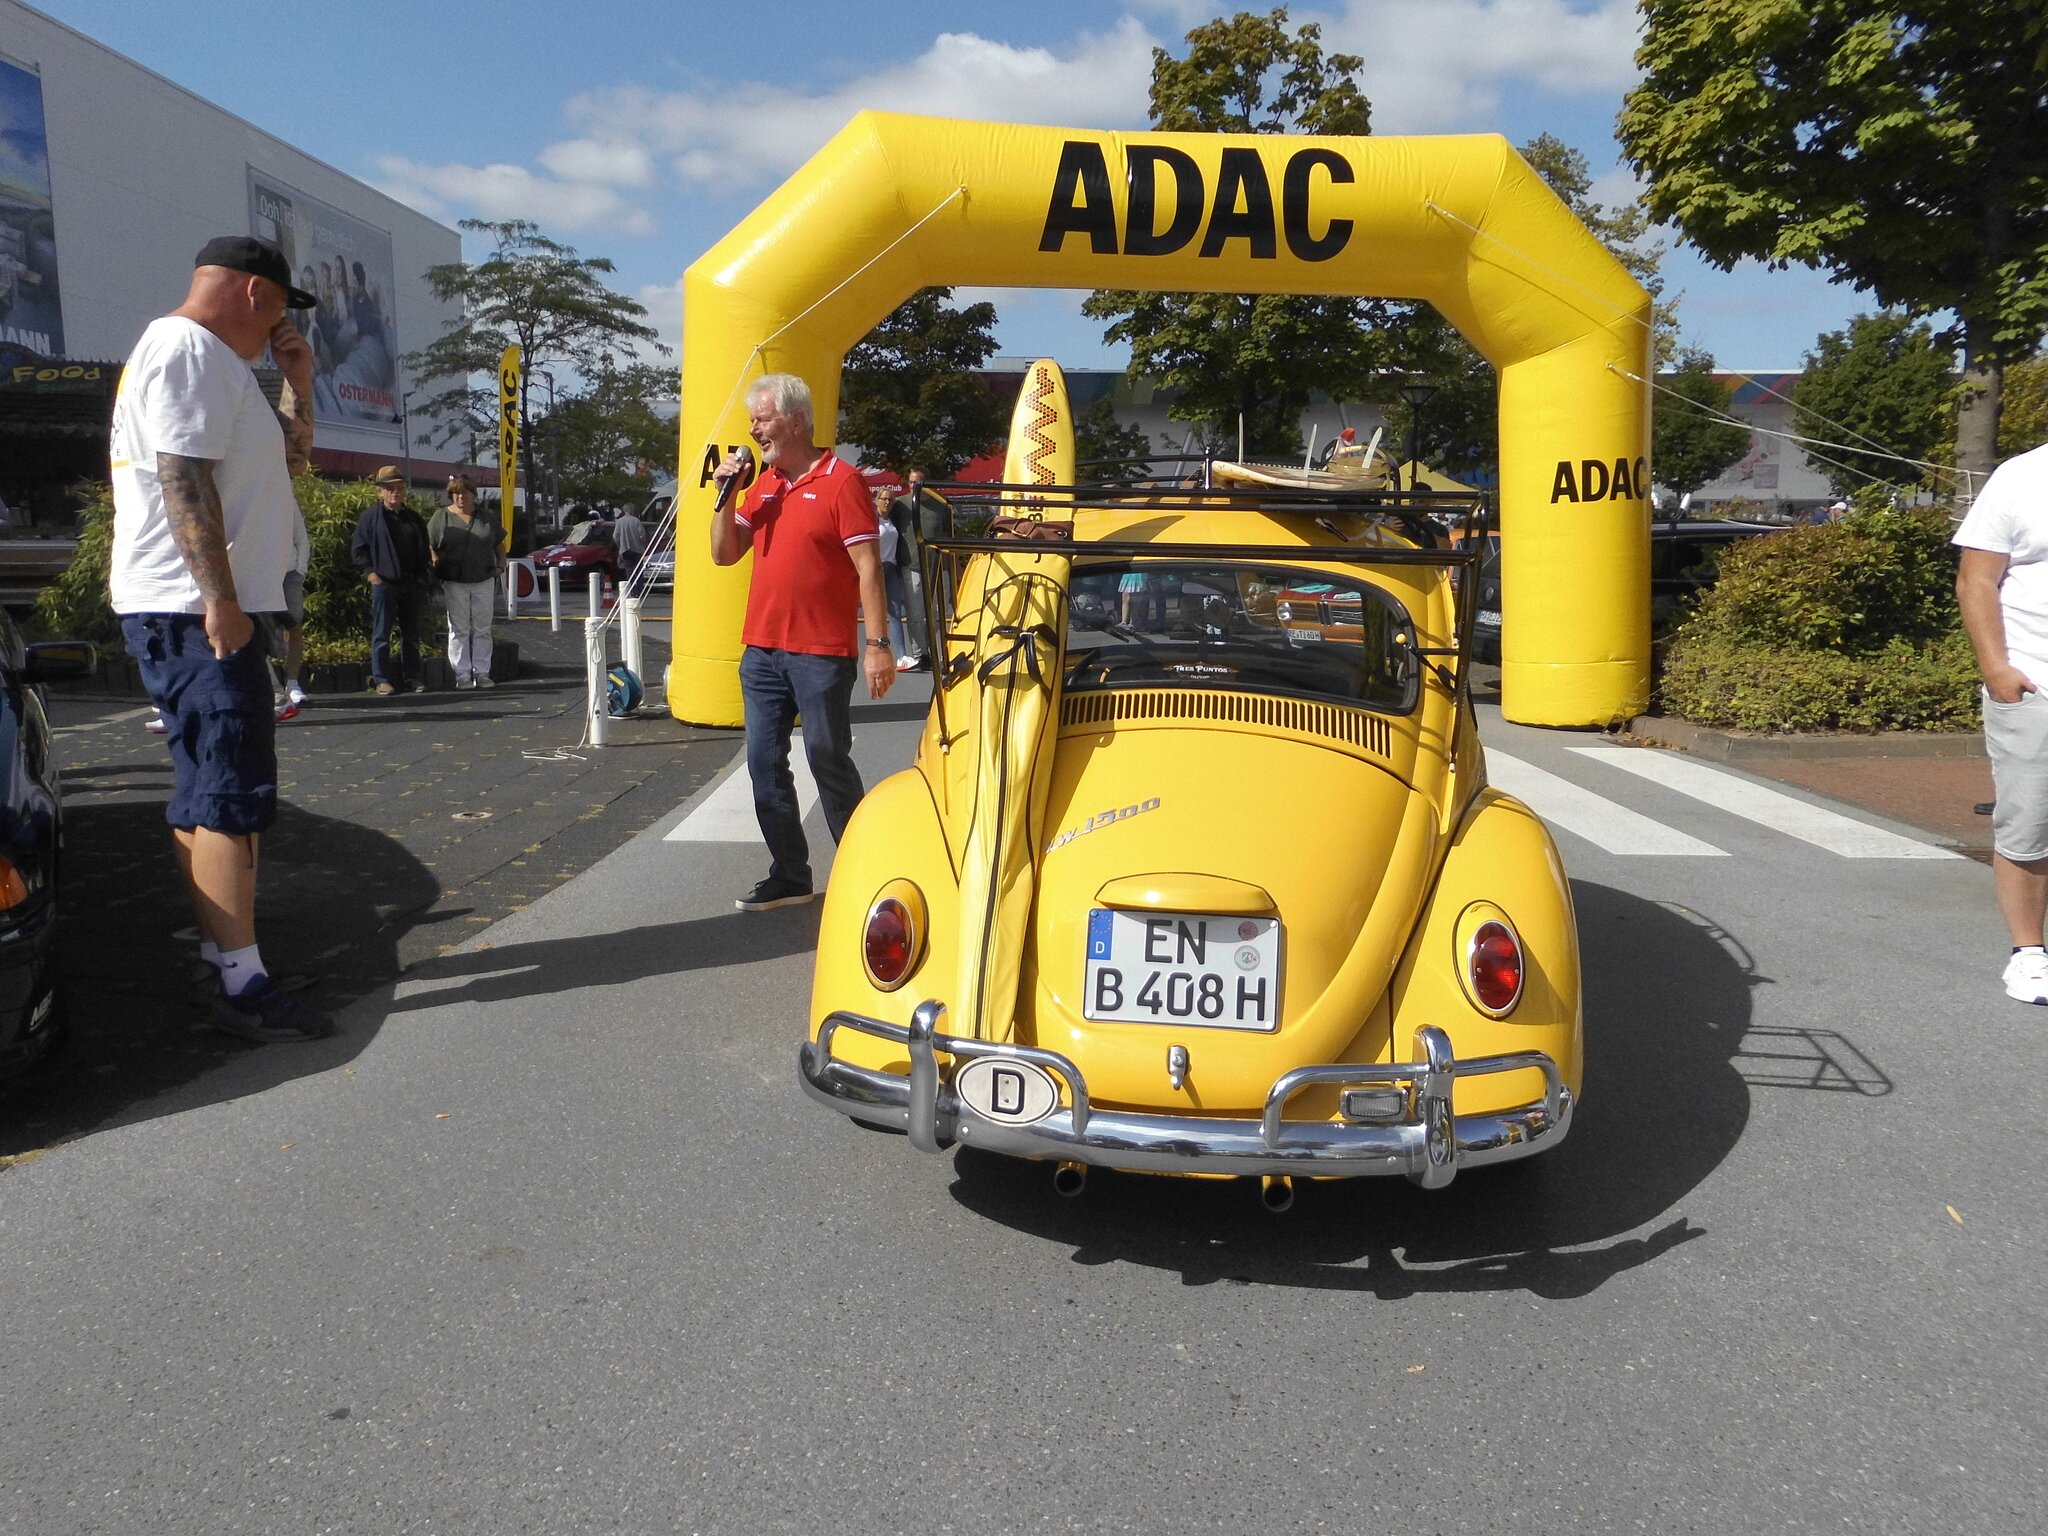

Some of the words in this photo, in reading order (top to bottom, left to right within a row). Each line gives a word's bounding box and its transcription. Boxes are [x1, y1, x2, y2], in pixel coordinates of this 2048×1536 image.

[1038, 141, 1355, 262] ADAC
[0, 322, 51, 357] ANN
[339, 382, 395, 407] OSTERMANN
[1550, 456, 1647, 504] ADAC
[1084, 797, 1160, 834] 1500
[1095, 941, 1105, 954] D
[1145, 918, 1206, 965] EN
[1096, 967, 1123, 1011] B
[1136, 970, 1224, 1019] 408
[1236, 975, 1266, 1021] H
[991, 1067, 1025, 1115] D
